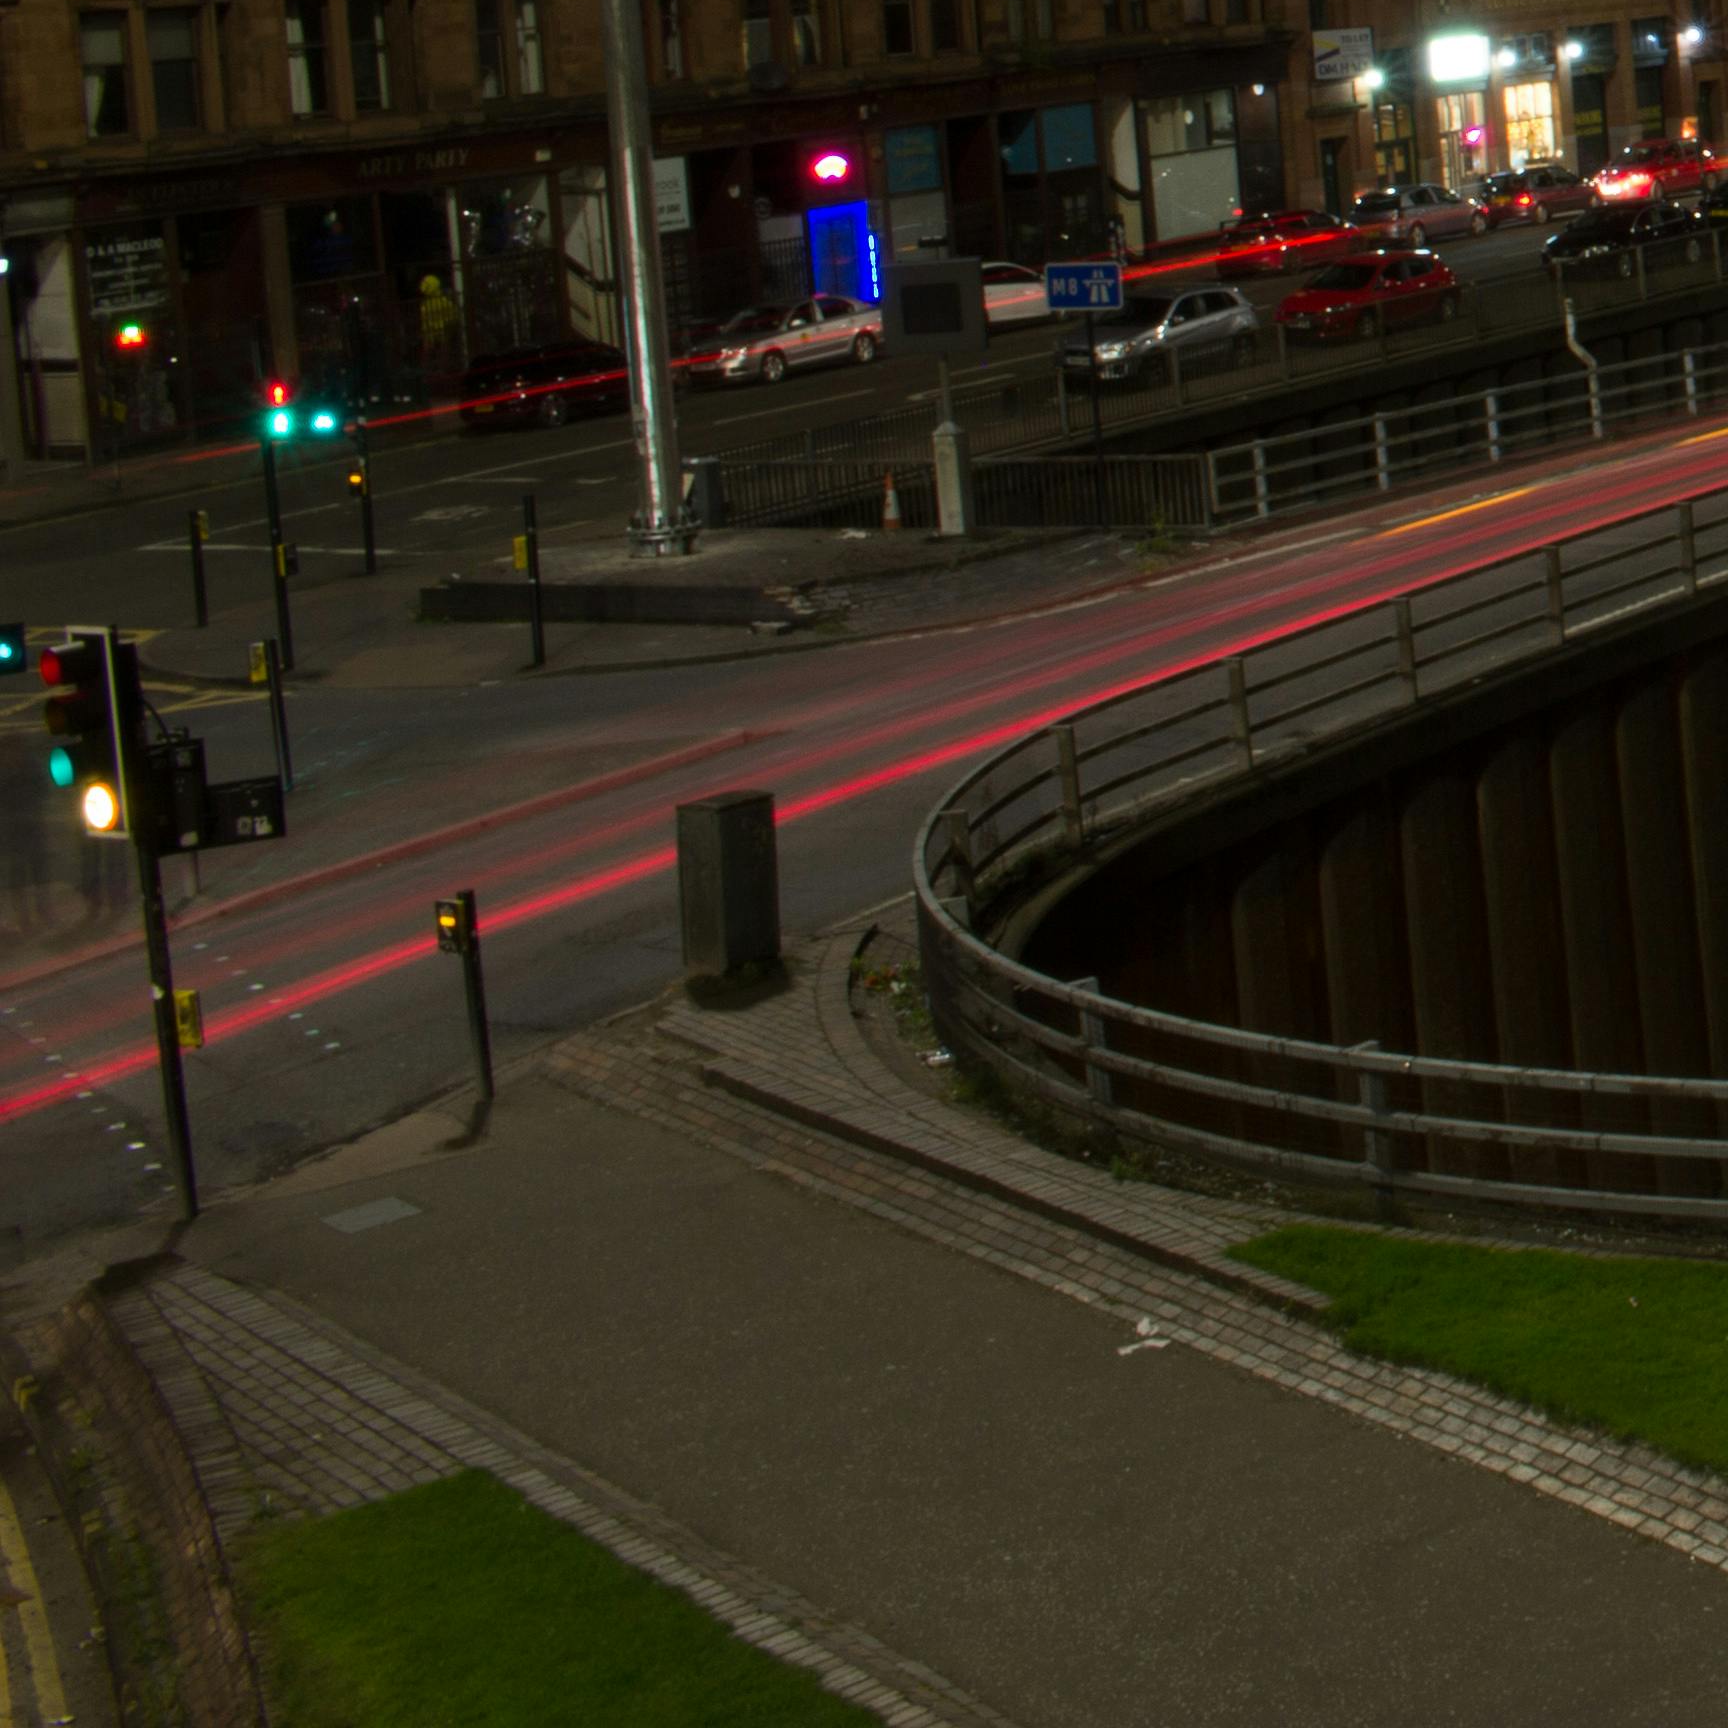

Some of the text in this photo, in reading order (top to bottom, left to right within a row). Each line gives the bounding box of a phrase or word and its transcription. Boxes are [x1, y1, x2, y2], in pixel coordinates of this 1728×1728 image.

[359, 145, 472, 177] ARTY PARTY
[1051, 277, 1079, 297] M8
